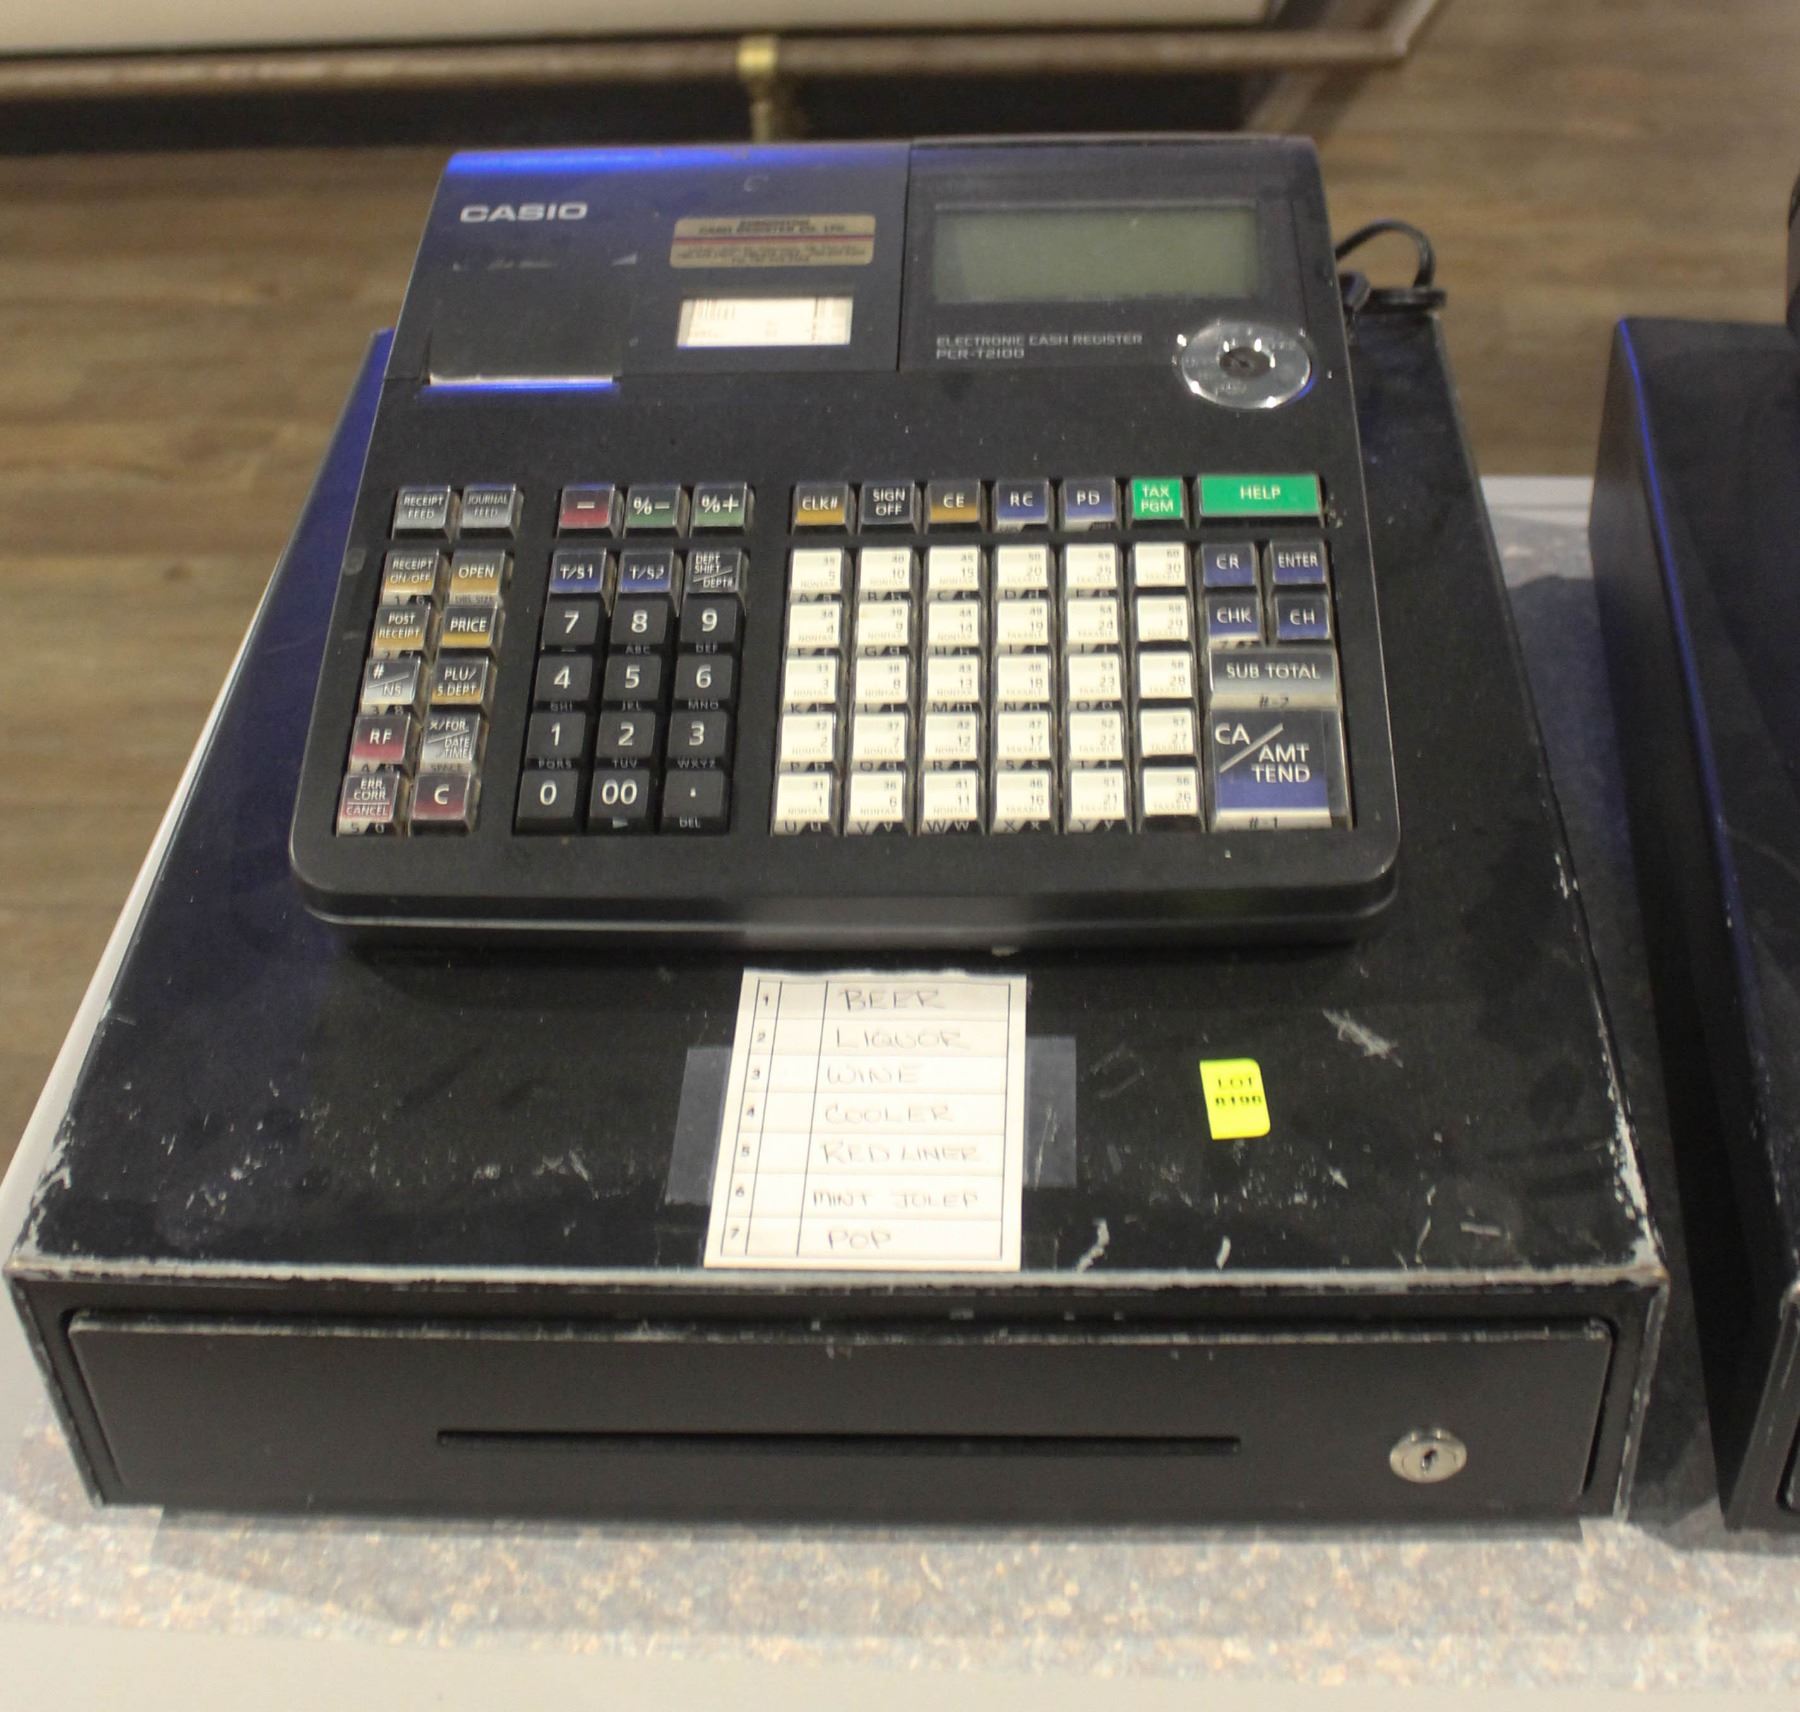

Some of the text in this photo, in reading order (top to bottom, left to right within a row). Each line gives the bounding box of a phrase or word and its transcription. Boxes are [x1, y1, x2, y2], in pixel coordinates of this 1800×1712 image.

[460, 203, 588, 222] CASIO
[935, 332, 1143, 347] ELECTRONIC CASH REGISTER
[403, 493, 444, 507] RECEIPT
[467, 492, 508, 505] JOURNAL
[872, 487, 906, 502] SIGN
[943, 492, 966, 509] CE
[1010, 490, 1034, 508] RC
[1076, 489, 1101, 507] PD
[1141, 484, 1171, 499] TAX
[1239, 484, 1283, 501] HELP
[802, 495, 838, 512] CLK#
[875, 503, 903, 518] OFF
[1140, 499, 1175, 514] PGM
[407, 508, 435, 521] FEED
[392, 557, 434, 571] RECEIPT
[1214, 553, 1241, 571] CR
[1276, 550, 1319, 570] ENTER
[390, 572, 432, 585] ON/OFF
[458, 563, 495, 579] OPEN
[694, 564, 721, 575] SHIFT
[388, 611, 417, 625] POST
[449, 615, 487, 633] PRICE
[563, 609, 580, 635] 7
[630, 608, 649, 635] 8
[701, 607, 719, 634] 9
[1215, 605, 1253, 625] CHK
[1288, 607, 1316, 626] CH
[378, 625, 420, 640] RECEIPT
[626, 642, 652, 654] ABC
[373, 661, 386, 680] #
[553, 664, 572, 691] 4
[623, 663, 642, 690] 5
[695, 663, 714, 690] 6
[1225, 660, 1321, 680] SUB TOTAL
[383, 683, 402, 696] NS
[370, 727, 394, 745] RF
[550, 720, 562, 748] 1
[617, 720, 636, 748] 2
[688, 719, 706, 748] 3
[1213, 722, 1250, 746] CA
[1257, 742, 1311, 764] AMT
[612, 757, 639, 769] TUV
[1250, 763, 1312, 784] TEND
[353, 789, 387, 802] CORR
[433, 783, 451, 806] C
[538, 778, 559, 807] 0
[601, 777, 639, 807] 00
[345, 805, 389, 817] CANCEL
[678, 815, 702, 829] DEL
[837, 987, 946, 1013] BEER
[835, 1026, 971, 1050] LIQUOR
[826, 1063, 920, 1084] WINE
[825, 1102, 956, 1124] COOLER
[812, 1190, 873, 1209] MINT
[826, 1226, 893, 1250] POP
